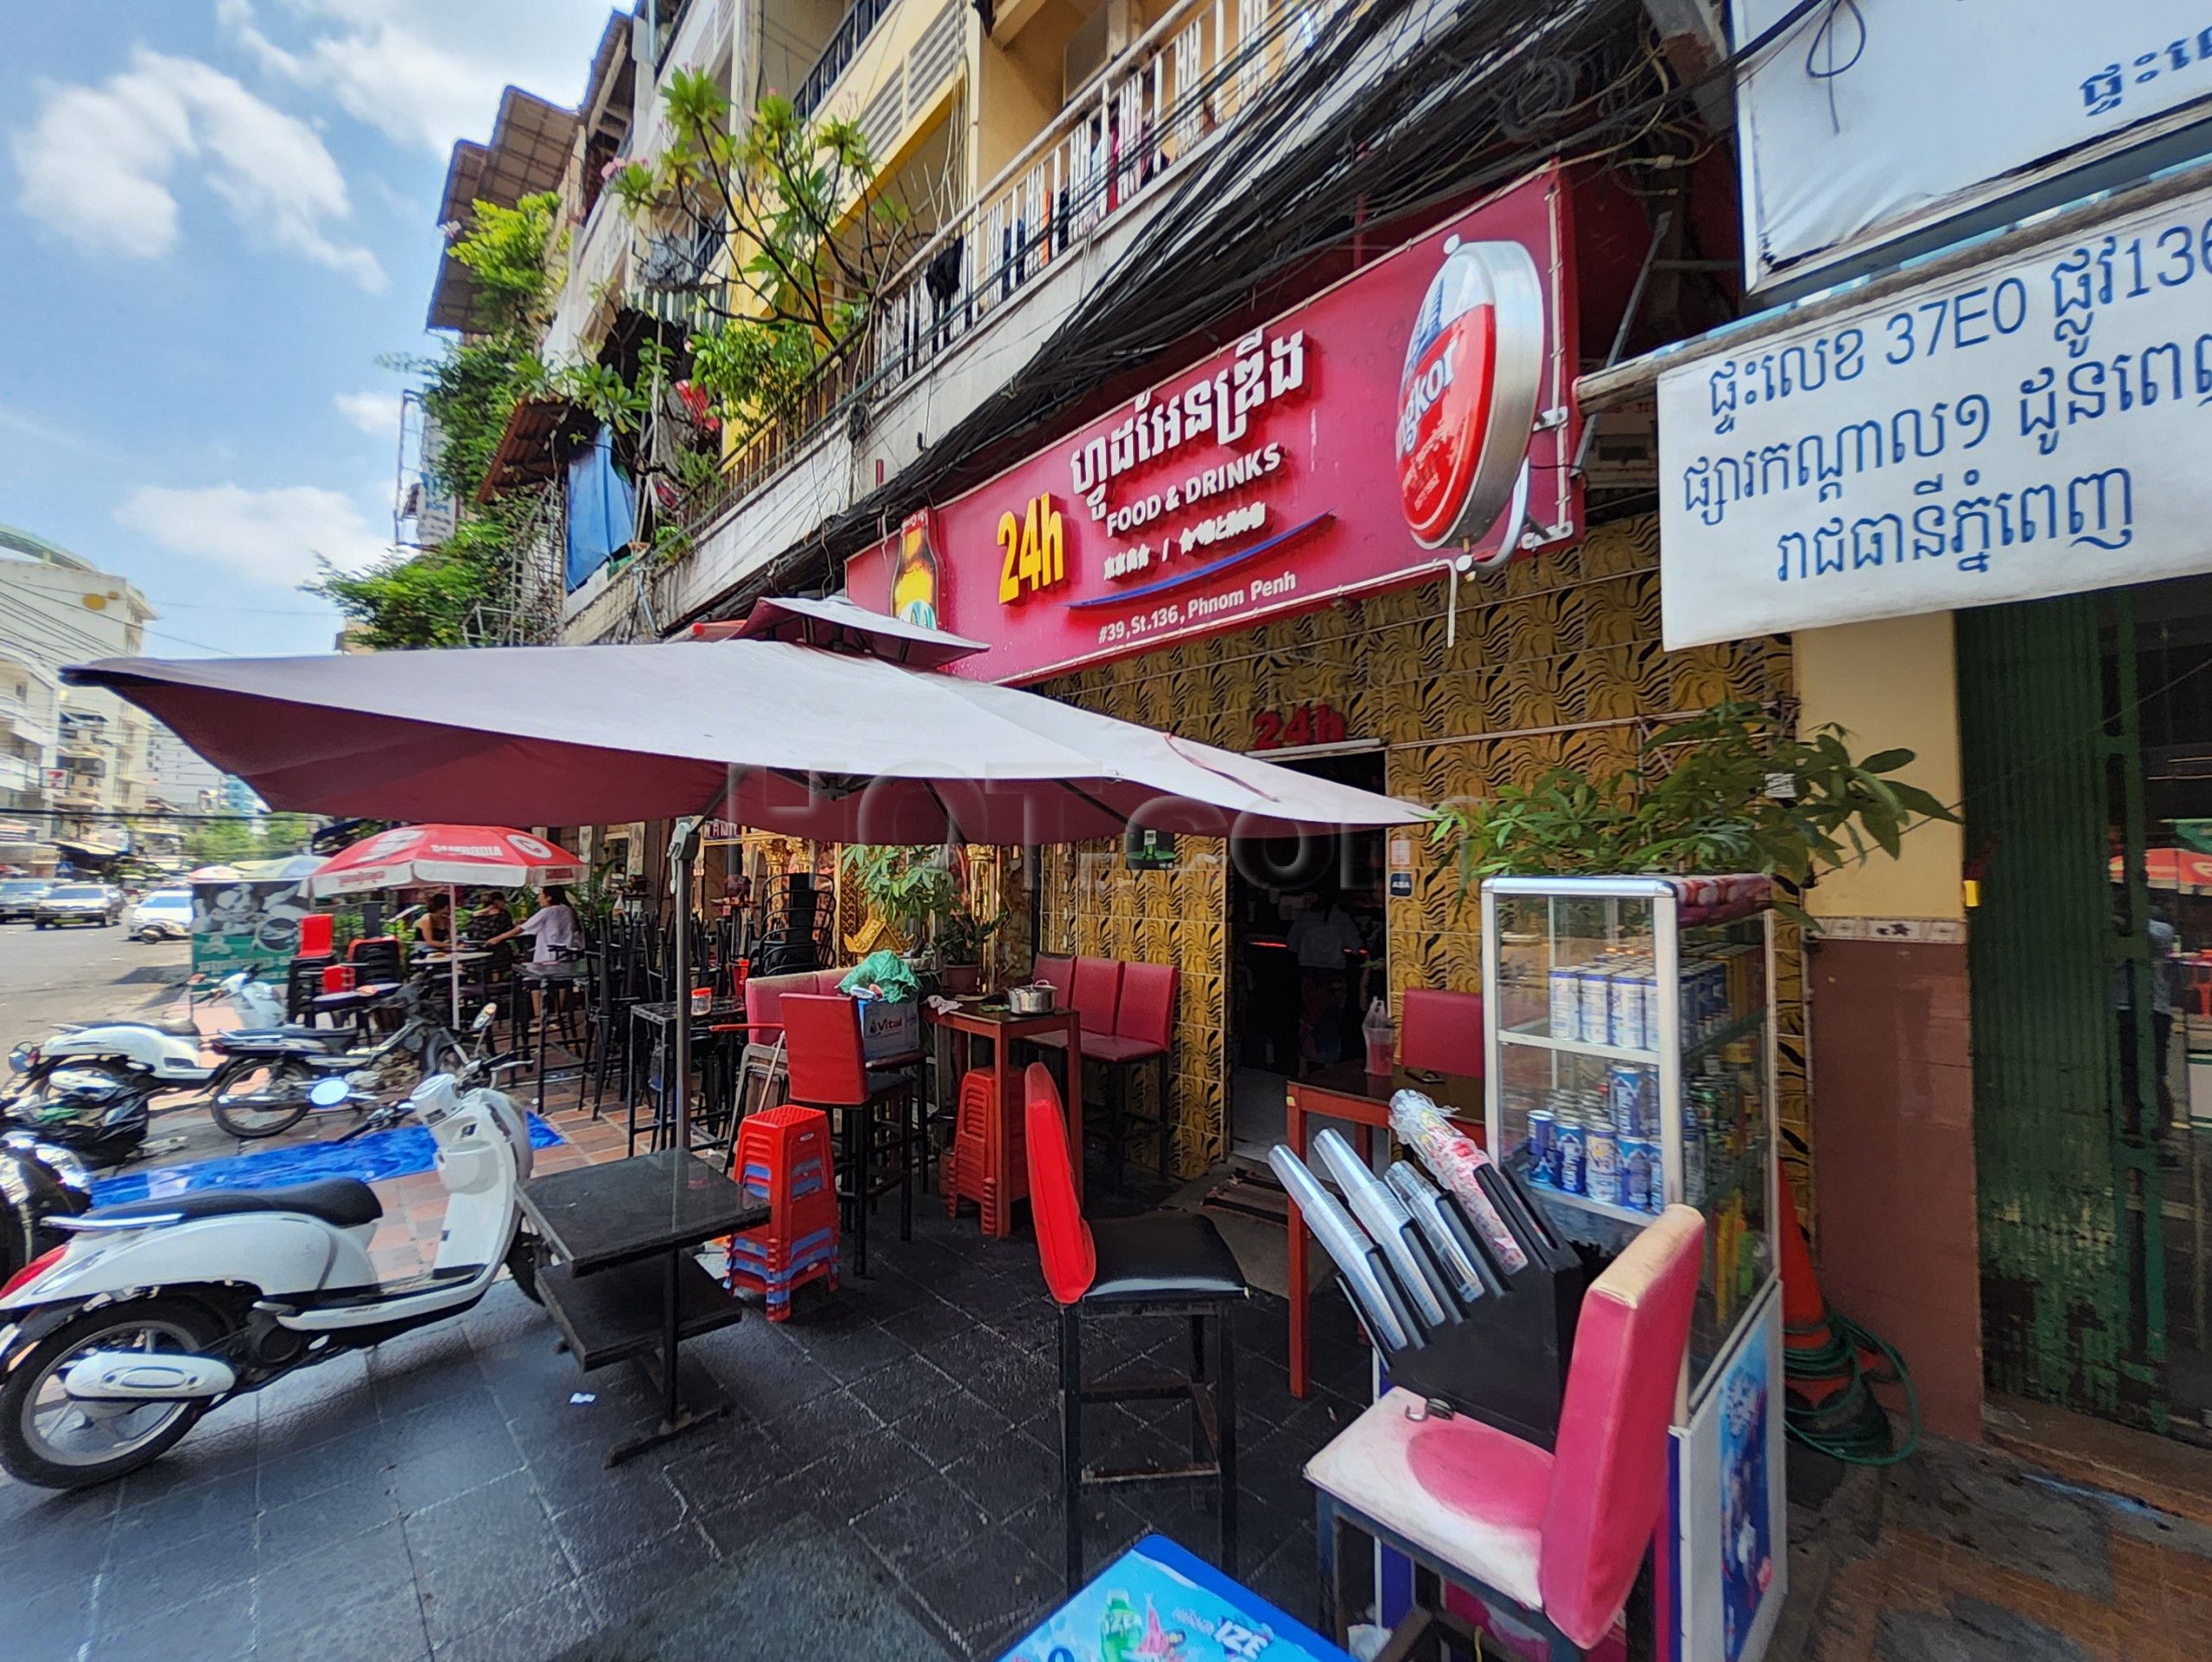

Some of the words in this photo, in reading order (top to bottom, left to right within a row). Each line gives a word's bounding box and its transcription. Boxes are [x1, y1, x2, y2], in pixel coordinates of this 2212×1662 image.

[1709, 328, 1865, 435] ផ្ទះលេខ
[1107, 494, 1162, 538] FOOD
[1166, 485, 1180, 512] &
[1185, 442, 1281, 505] DRINKS
[1777, 468, 2133, 573] រាជធានីភ្នំពេញ
[997, 491, 1065, 604] 24h
[1188, 590, 1244, 620] Phnom
[1250, 571, 1297, 601] Penh
[1253, 703, 1348, 751] 24h
[878, 1018, 903, 1032] Vital
